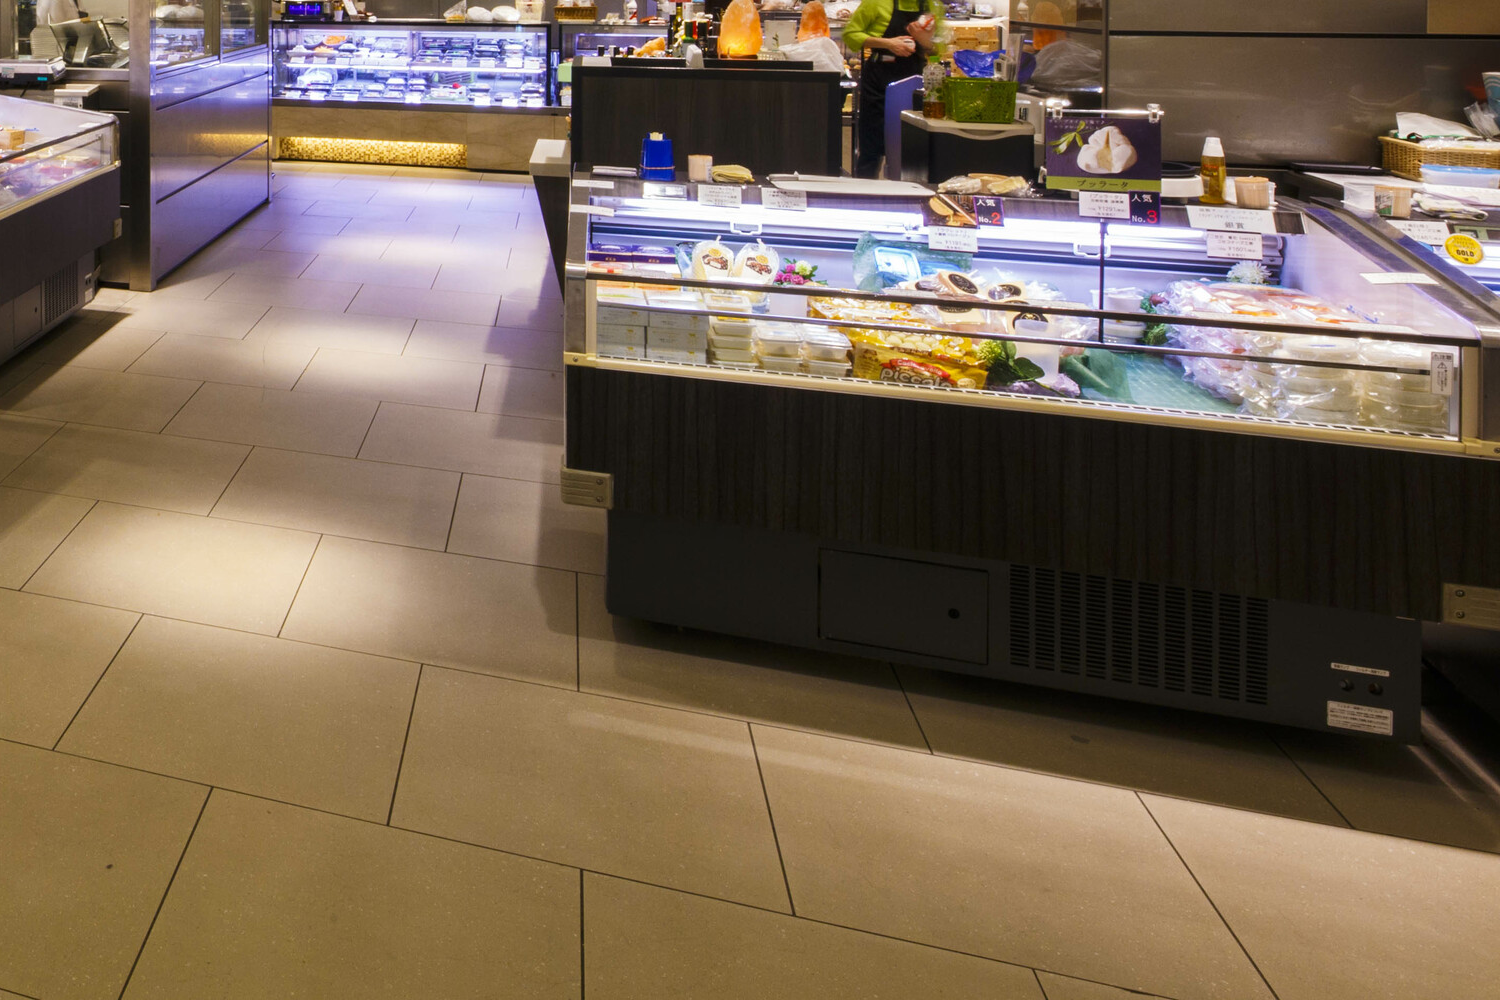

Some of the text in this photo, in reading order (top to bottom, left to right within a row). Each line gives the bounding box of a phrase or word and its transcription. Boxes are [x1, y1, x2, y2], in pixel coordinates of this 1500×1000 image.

[976, 198, 996, 207] 人気
[1131, 193, 1153, 203] 人気
[978, 211, 1002, 225] No.2
[1131, 209, 1158, 224] No.3
[1456, 248, 1475, 258] GOLD
